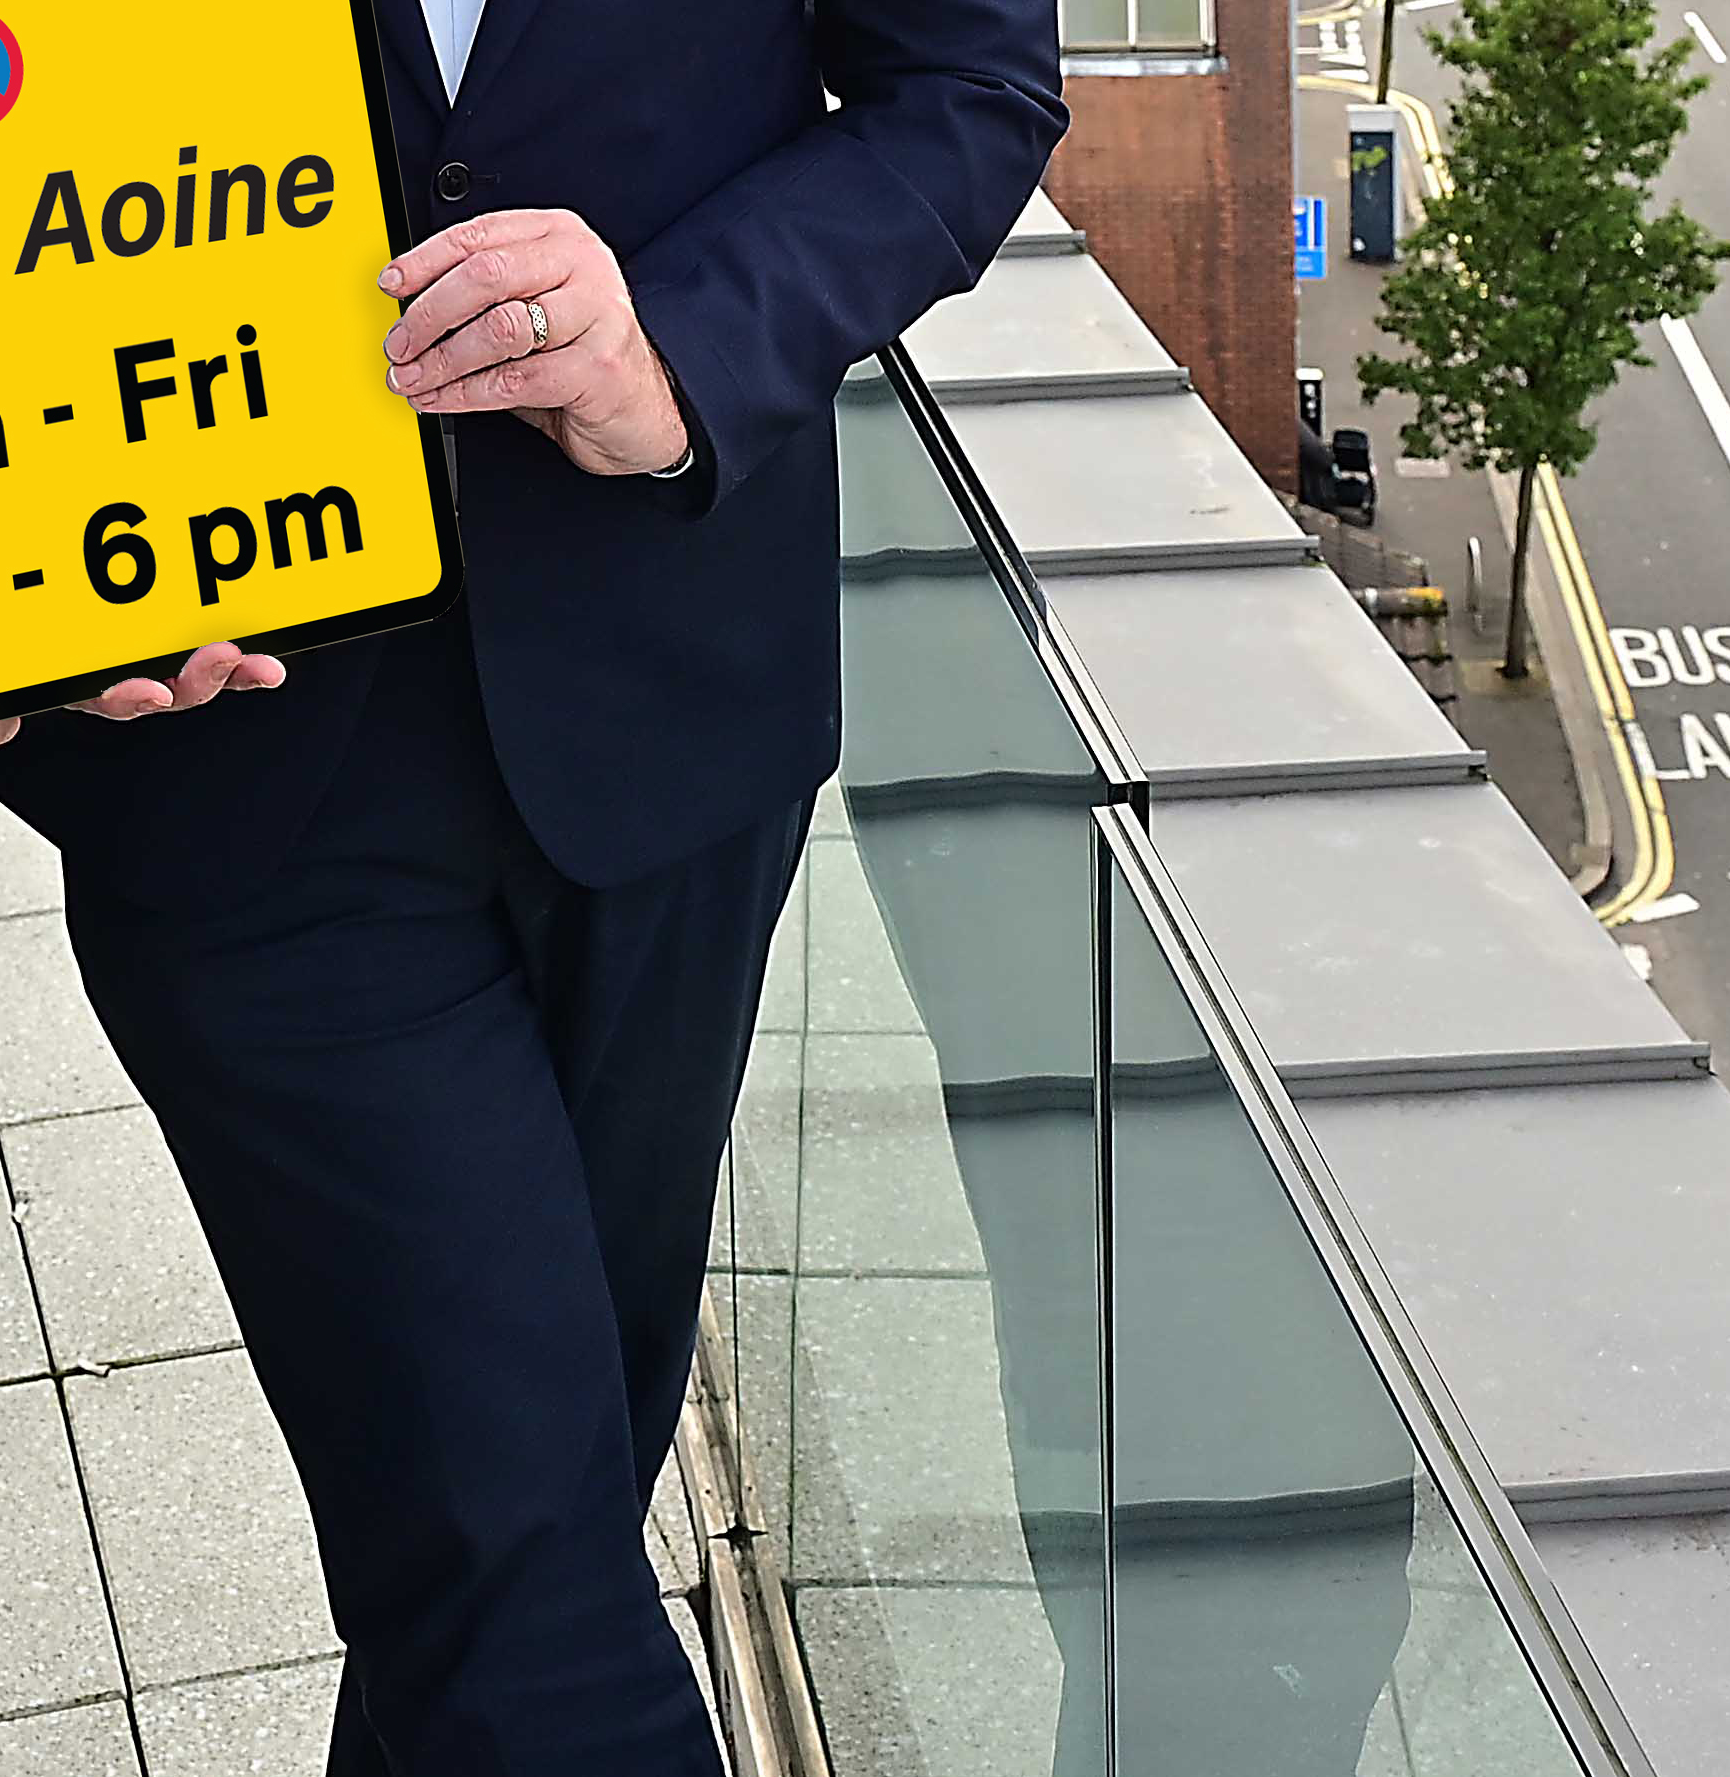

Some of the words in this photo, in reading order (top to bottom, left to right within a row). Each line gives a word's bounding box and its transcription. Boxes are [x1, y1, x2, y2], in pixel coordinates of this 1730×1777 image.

[15, 146, 334, 274] Aoine
[43, 404, 74, 424] -
[114, 324, 268, 443] Fri
[13, 569, 44, 590] -
[83, 502, 156, 604] 6
[189, 486, 363, 606] pm
